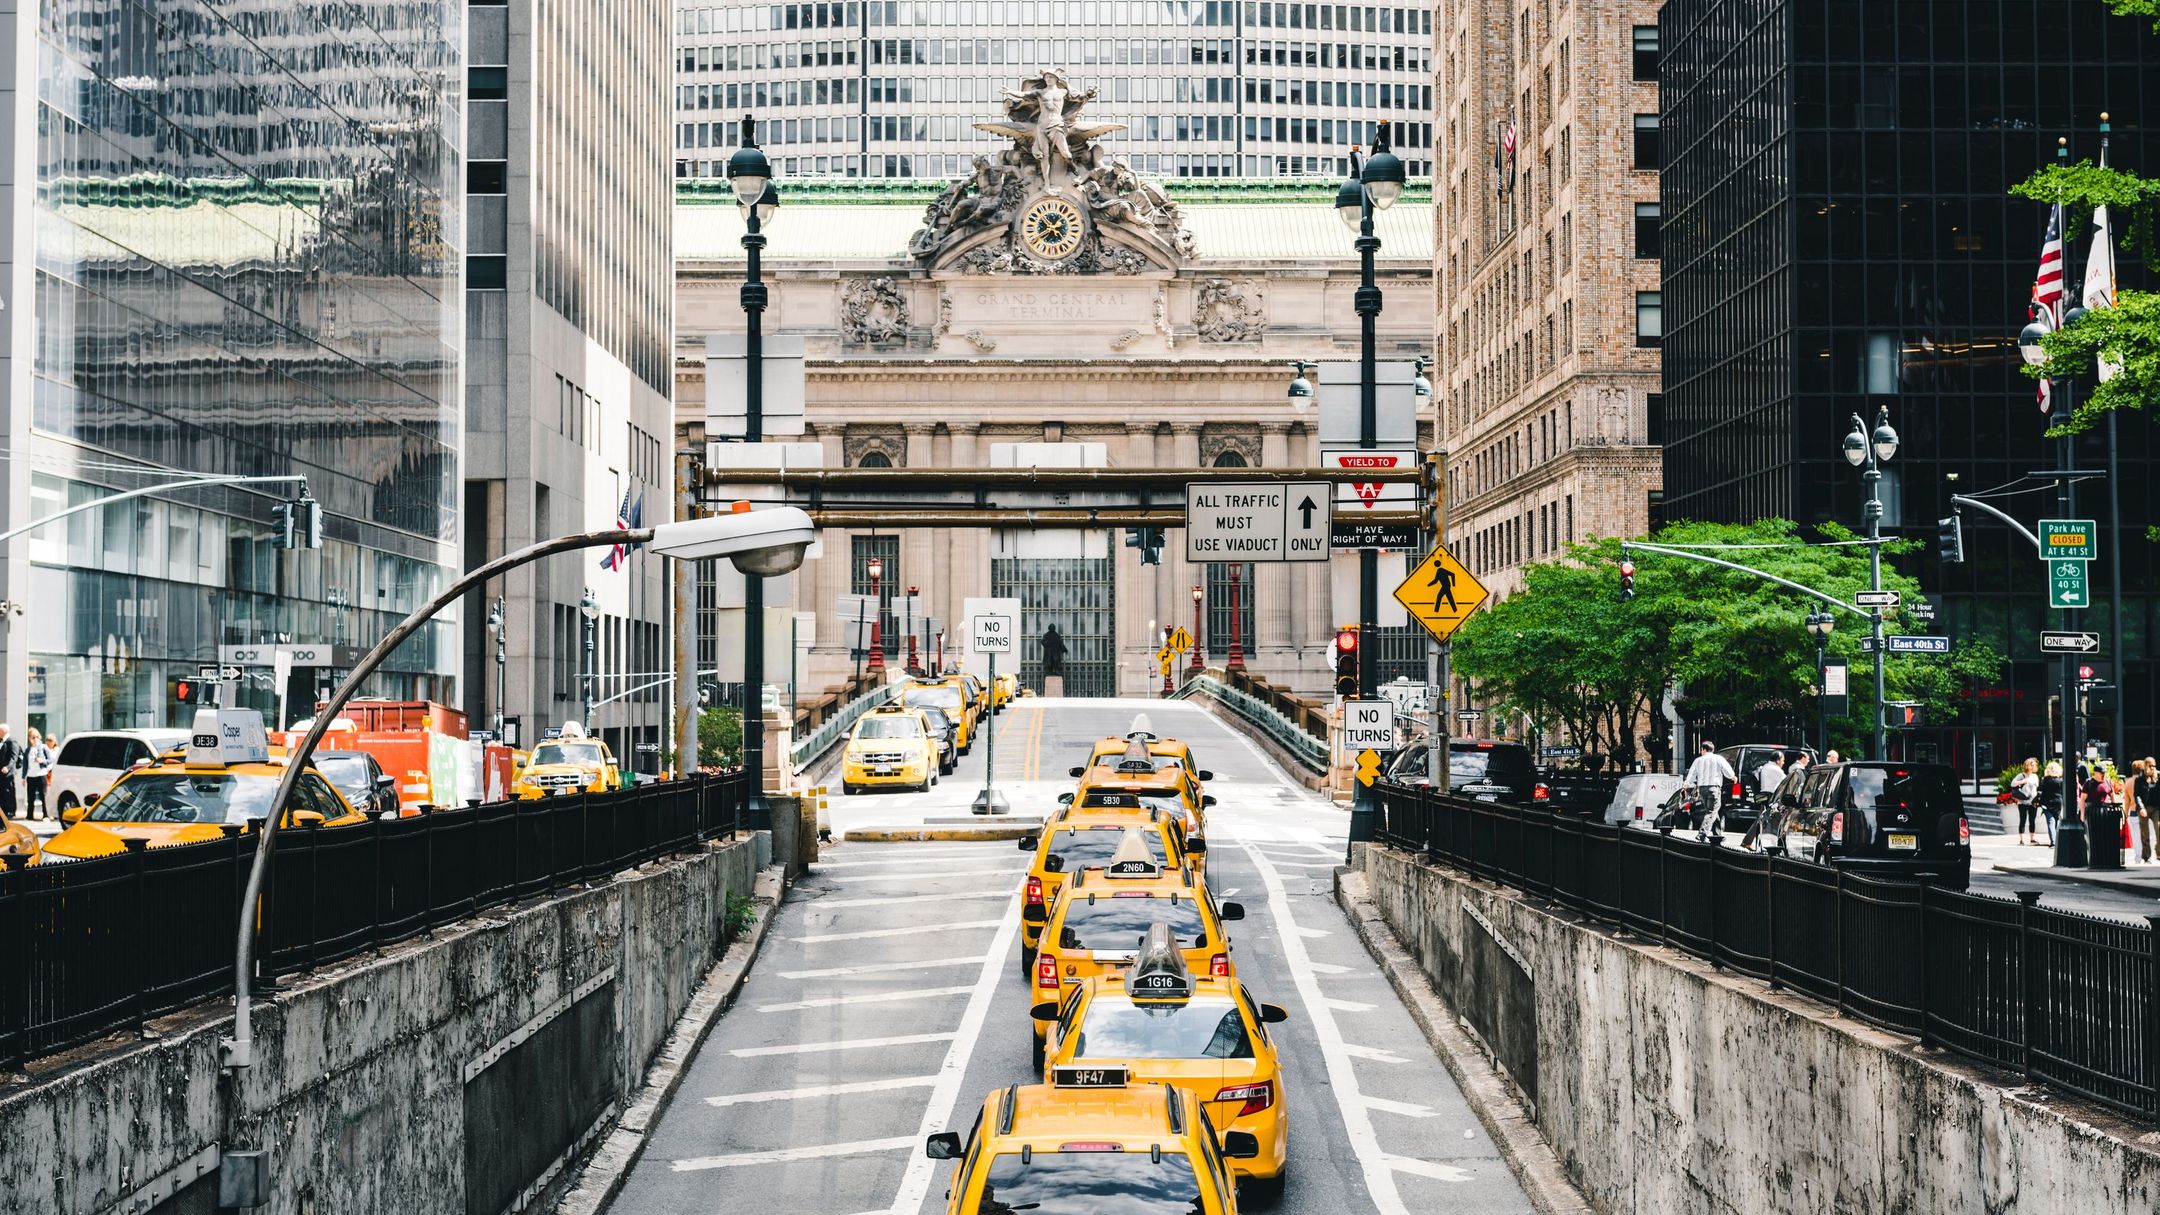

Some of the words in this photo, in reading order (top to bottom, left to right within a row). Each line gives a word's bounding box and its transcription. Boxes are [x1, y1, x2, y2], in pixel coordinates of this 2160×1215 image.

[976, 294, 1037, 305] GRAND
[1050, 294, 1128, 305] CENTRAL
[1010, 307, 1095, 318] TERMINAL
[1346, 458, 1375, 467] YIELD
[1377, 458, 1390, 467] TO
[1196, 495, 1220, 508] ALL
[1225, 495, 1280, 508] TRAFFIC
[1216, 516, 1253, 529] MUST
[1355, 526, 1384, 534] HAVE
[2048, 524, 2068, 533] Park
[2070, 524, 2086, 533] Ave
[1195, 538, 1220, 551] USE
[1226, 538, 1278, 551] VIADUCT
[1291, 538, 1323, 551] ONLY
[1332, 535, 1361, 543] RIGHT
[1365, 535, 1377, 543] OF
[1382, 535, 1407, 543] WAY!
[2052, 535, 2083, 544] CLOSED
[2047, 547, 2057, 556] AT
[2060, 547, 2065, 556] E
[2068, 547, 2077, 556] 41
[2080, 547, 2088, 556] St
[2058, 580, 2069, 589] 40
[2071, 580, 2080, 589] St
[1917, 603, 1933, 611] Hour
[984, 621, 1000, 632] NO
[976, 636, 1009, 647] TURNS
[1893, 639, 1913, 649] East
[1914, 639, 1933, 649] 40th
[1934, 640, 1945, 650] St
[2045, 638, 2064, 646] ONE
[2074, 638, 2092, 647] WAY
[1358, 709, 1379, 723] NO
[1347, 729, 1391, 742] TURNS
[1102, 796, 1120, 805] 5B30
[1123, 863, 1144, 872] 2N60
[1147, 977, 1173, 988] 1G16
[1075, 1070, 1105, 1084] 9F47
